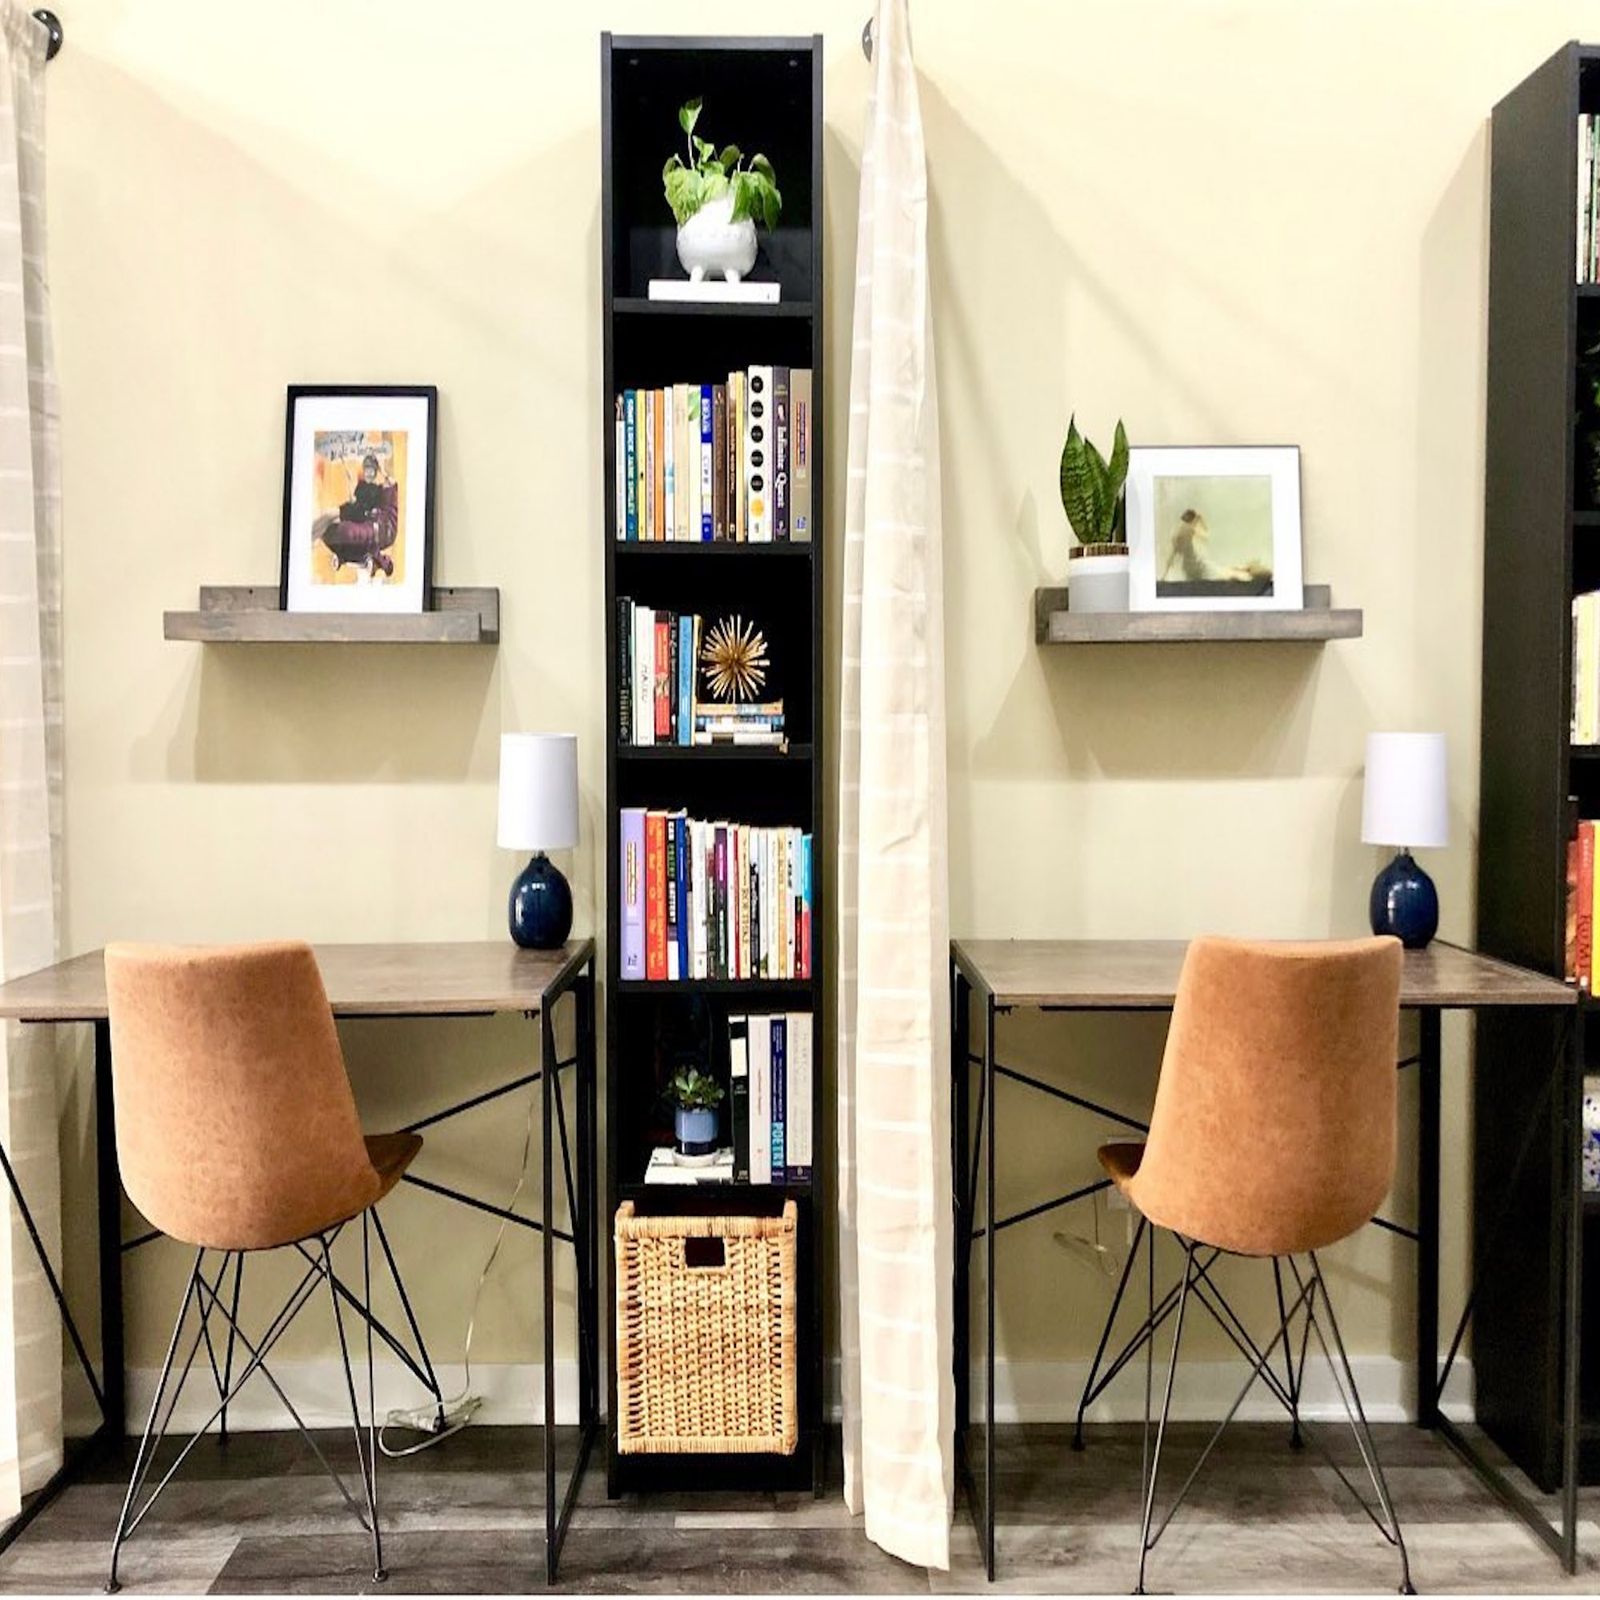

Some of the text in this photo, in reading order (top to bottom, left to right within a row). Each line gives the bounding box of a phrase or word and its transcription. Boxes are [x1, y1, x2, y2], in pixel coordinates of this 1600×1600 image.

[774, 472, 788, 509] Quest
[1578, 914, 1590, 969] RUMI
[772, 1121, 784, 1168] POETRY
